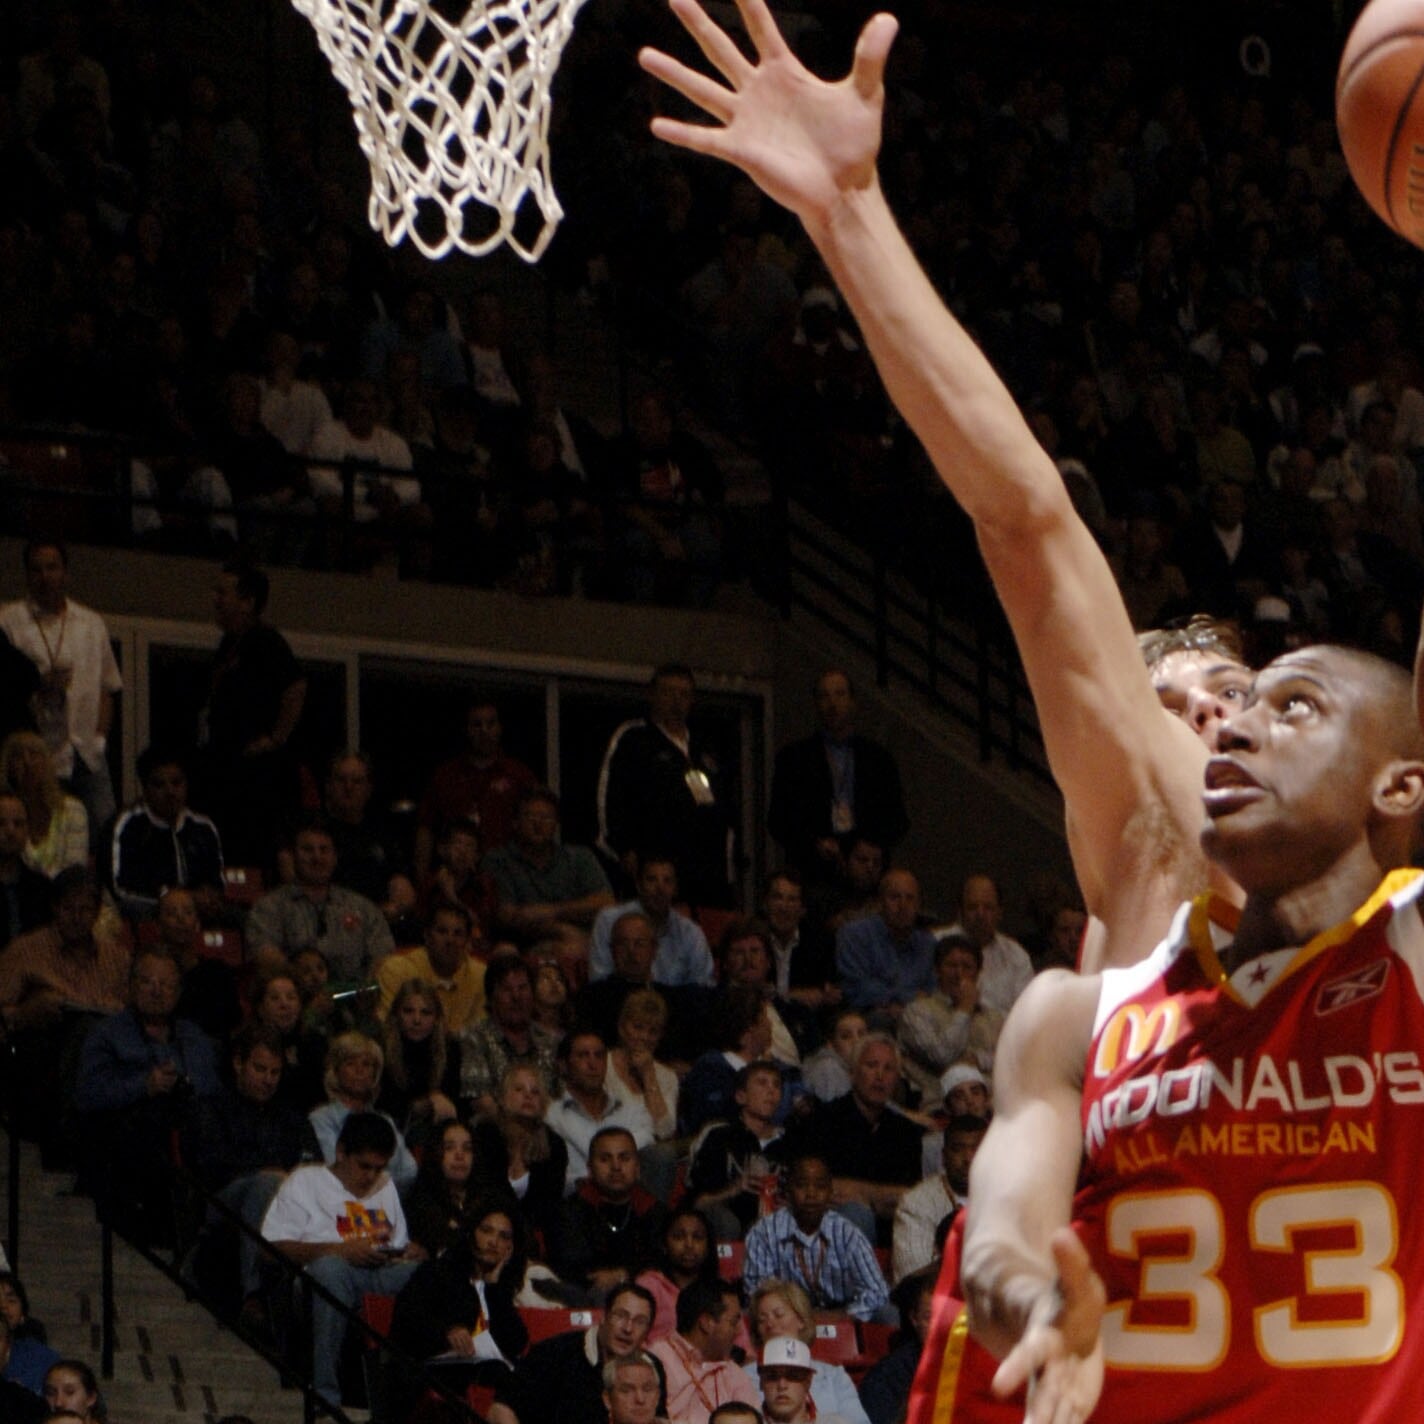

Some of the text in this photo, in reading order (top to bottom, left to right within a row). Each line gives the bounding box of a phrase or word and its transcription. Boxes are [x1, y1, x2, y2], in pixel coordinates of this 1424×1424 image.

[1113, 1121, 1377, 1175] ALL AMERICAN
[1103, 1179, 1406, 1373] 33
